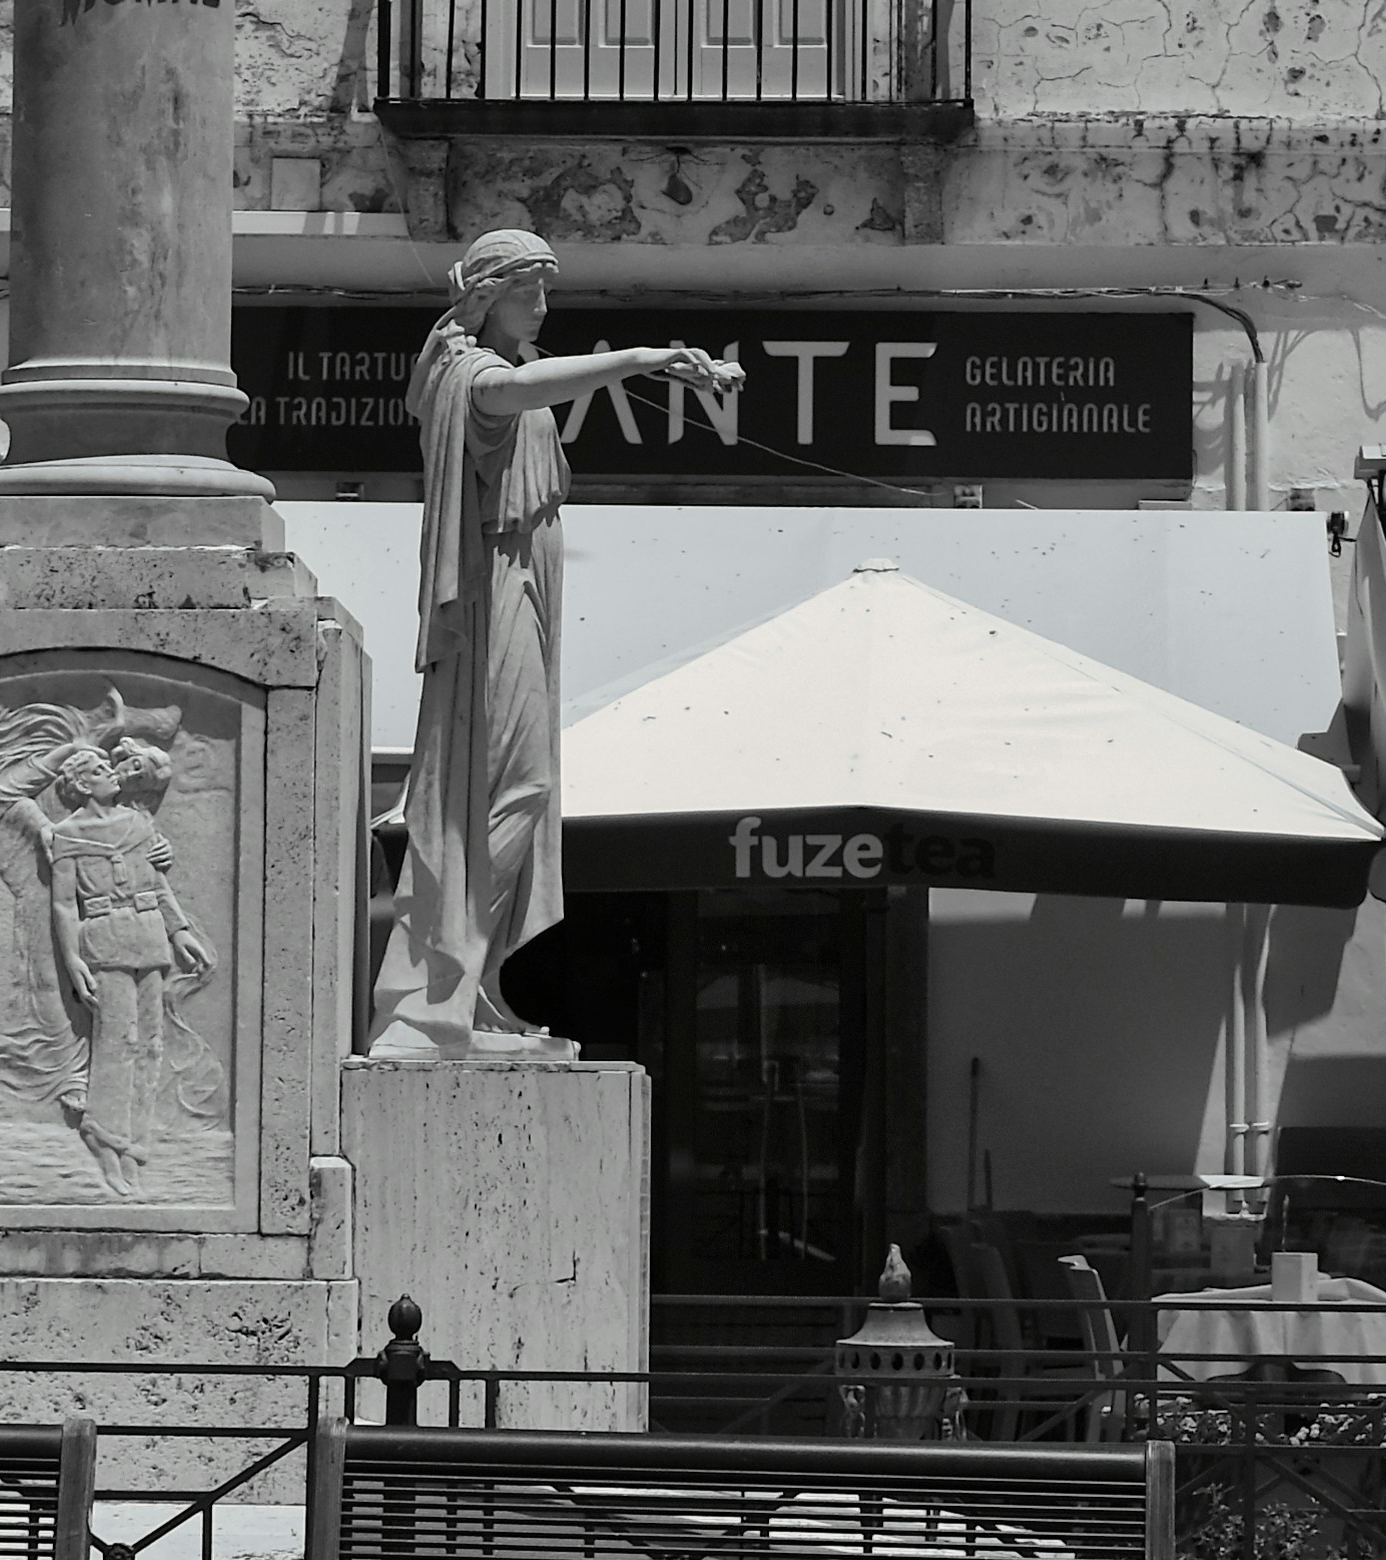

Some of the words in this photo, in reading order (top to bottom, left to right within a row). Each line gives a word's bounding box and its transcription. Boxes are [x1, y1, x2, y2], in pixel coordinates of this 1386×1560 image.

[288, 351, 311, 380] IL
[965, 355, 1115, 387] GELATERIA
[521, 339, 938, 446] ANTE
[965, 402, 1151, 433] ARTIGIANALE
